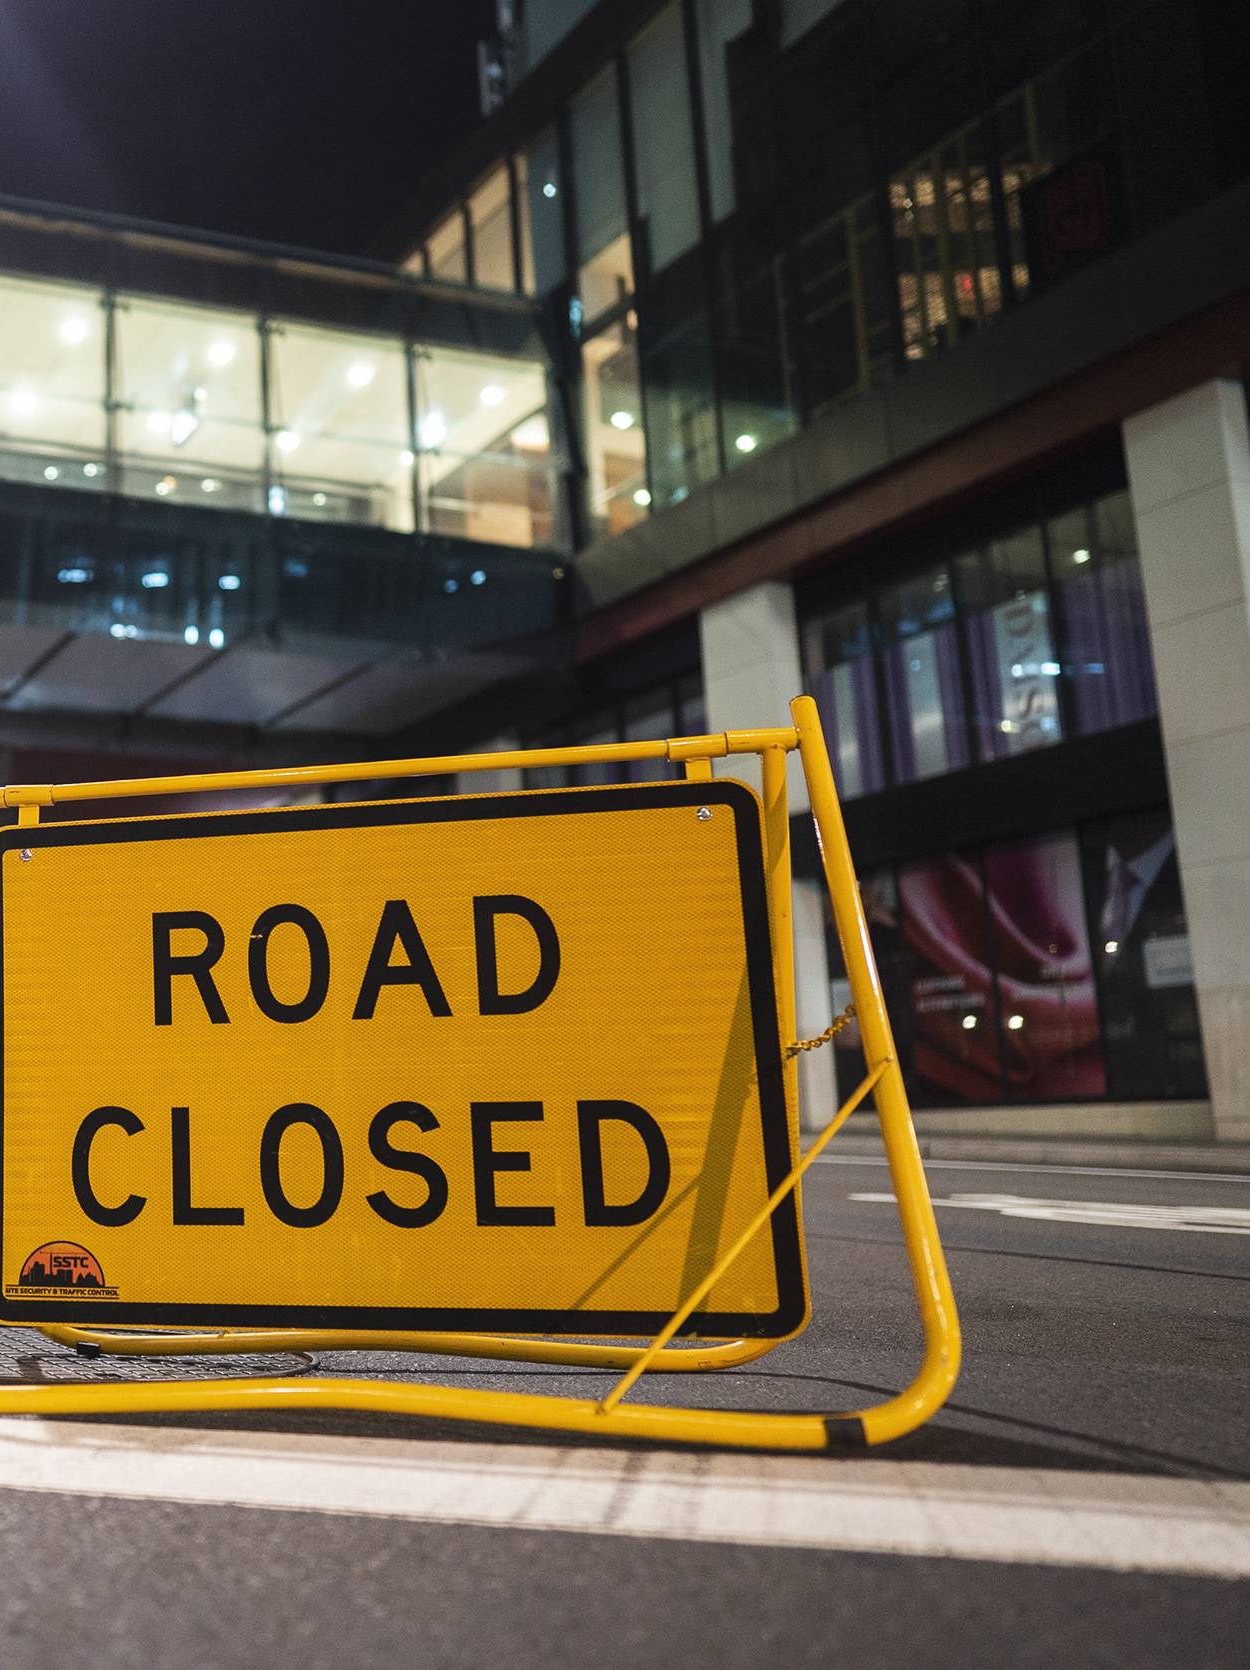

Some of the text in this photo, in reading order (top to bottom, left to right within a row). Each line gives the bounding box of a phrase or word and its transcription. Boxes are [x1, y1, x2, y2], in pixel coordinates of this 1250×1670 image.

[152, 894, 562, 1026] ROAD
[71, 1100, 671, 1229] CLOSED
[5, 1287, 19, 1295] SITE
[20, 1287, 52, 1295] SECURITY
[59, 1288, 87, 1296] TRAFFIC
[88, 1289, 120, 1297] CONTROL
[53, 1256, 89, 1269] SSTC
